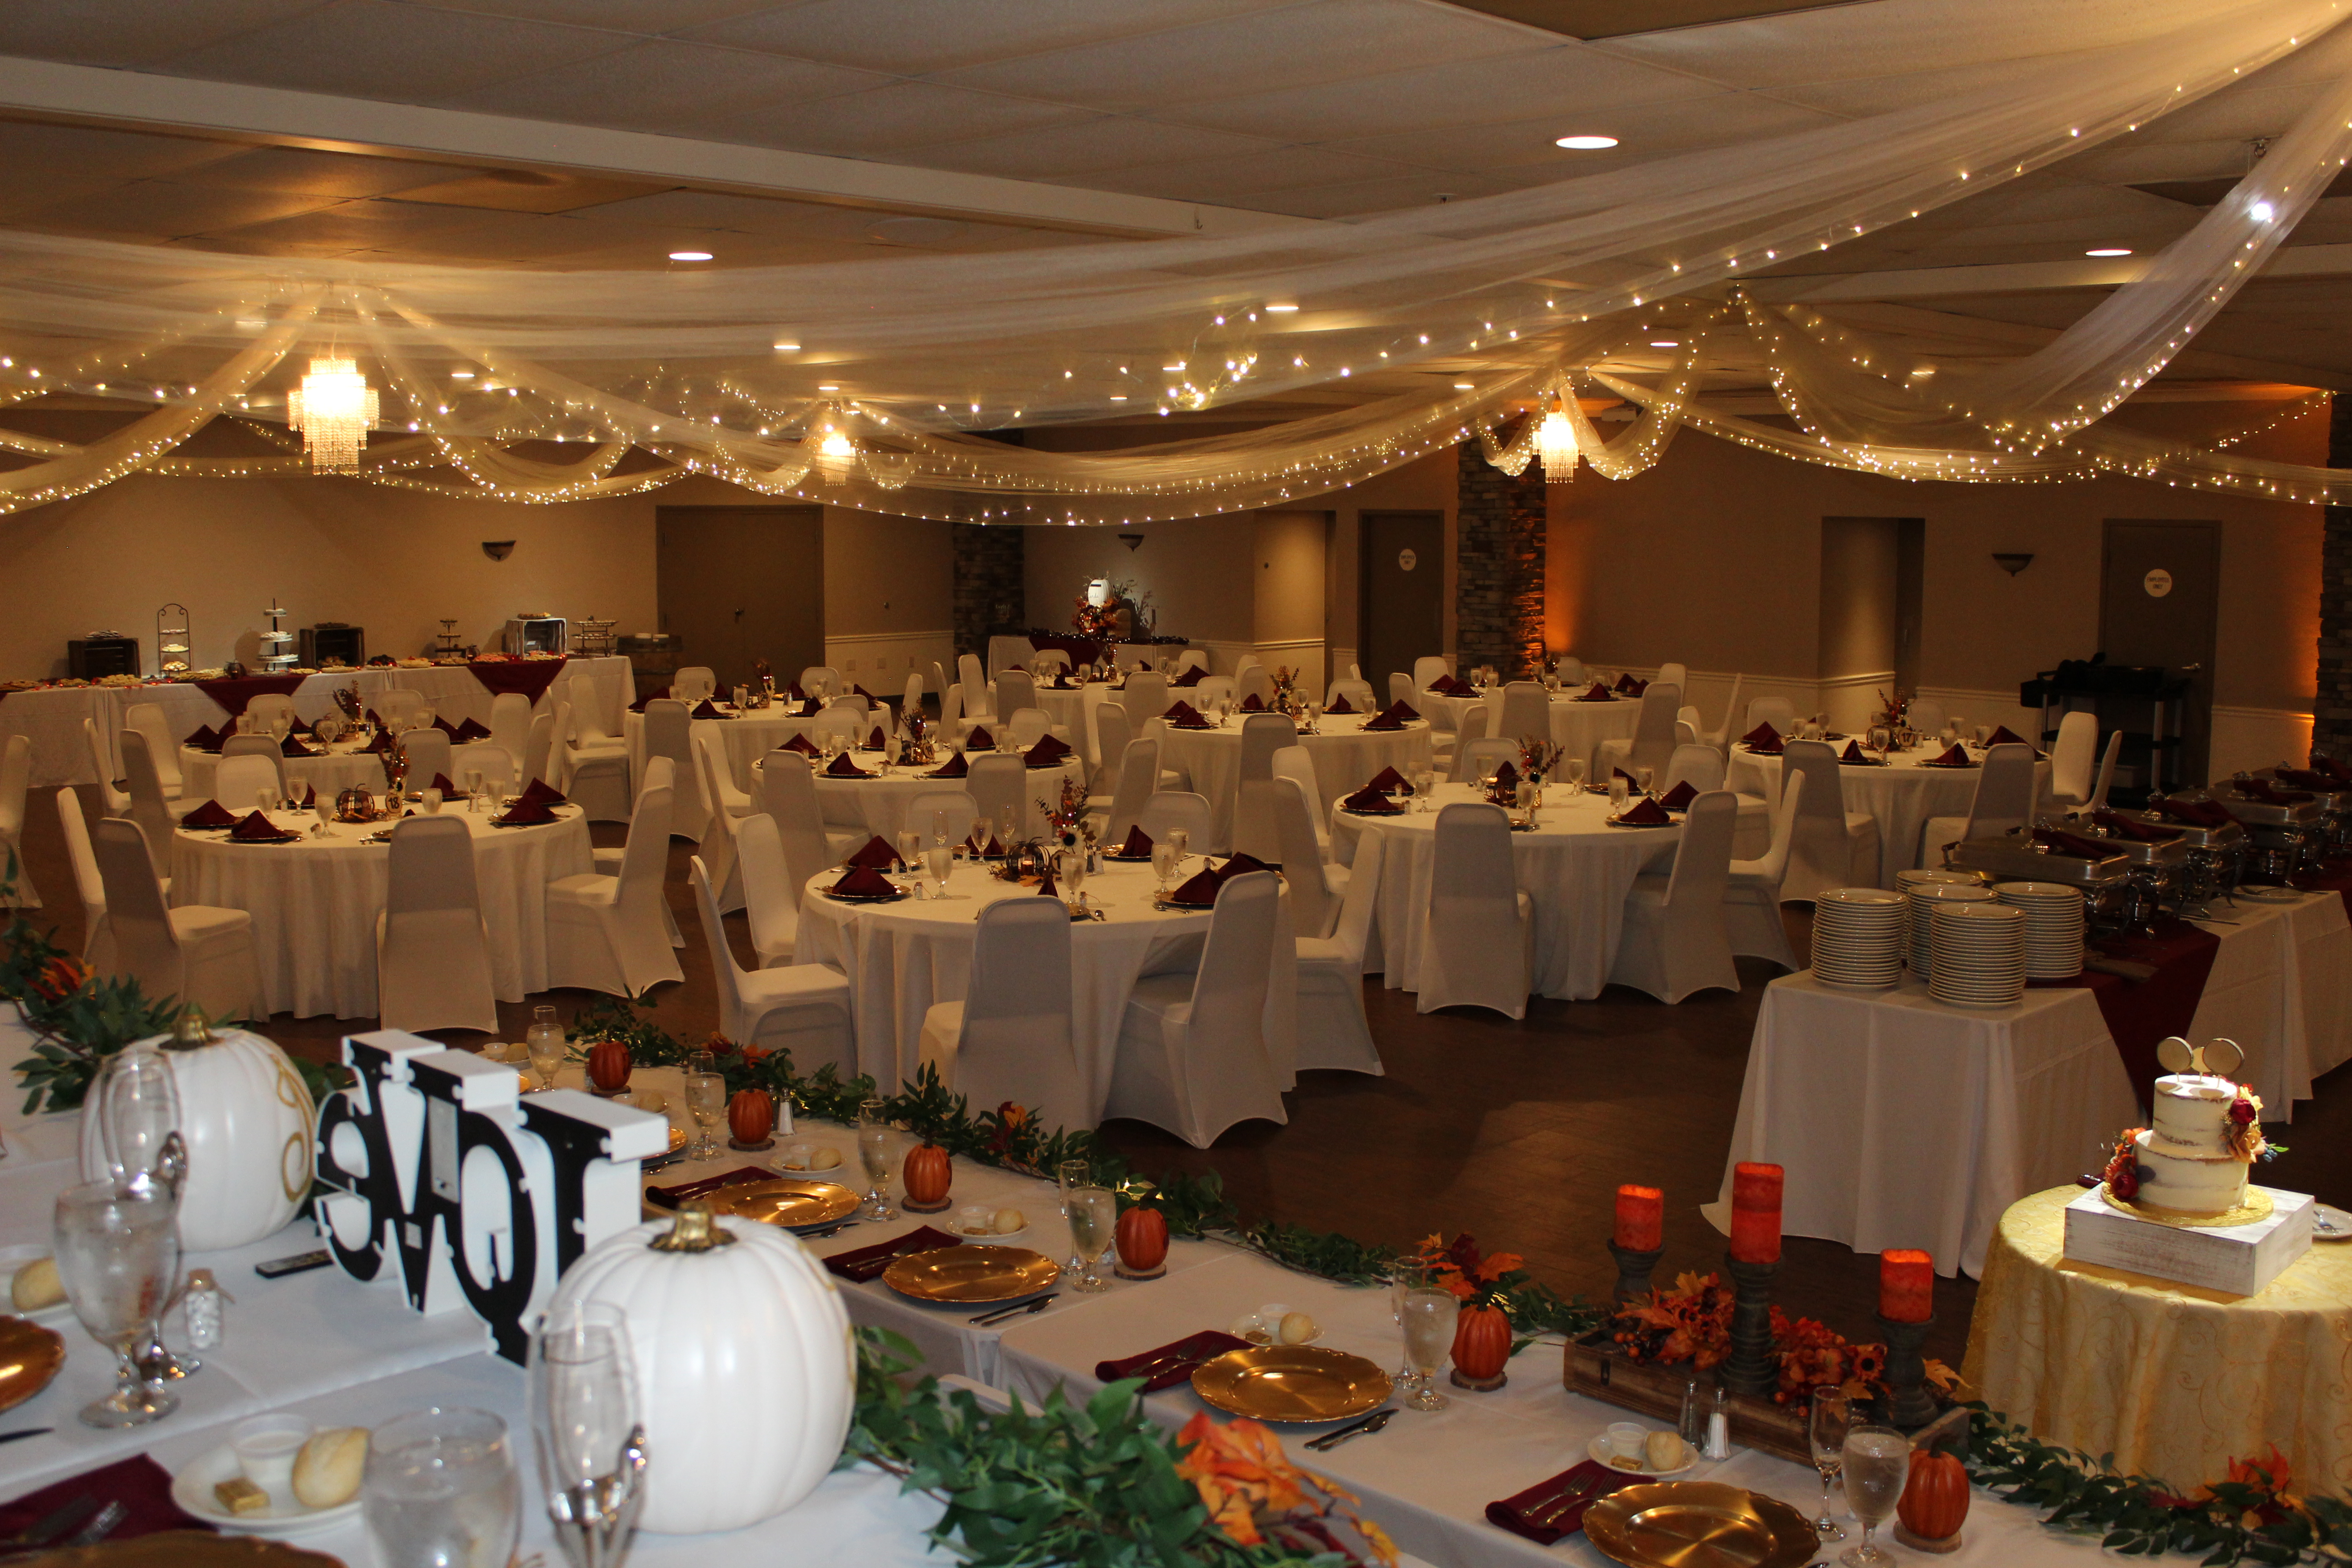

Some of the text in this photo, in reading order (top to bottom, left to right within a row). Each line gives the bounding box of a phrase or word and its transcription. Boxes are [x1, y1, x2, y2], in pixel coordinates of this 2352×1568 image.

[1294, 706, 1302, 715] 20
[345, 724, 357, 733] 23
[1902, 732, 1912, 743] 17
[388, 797, 400, 809] 18
